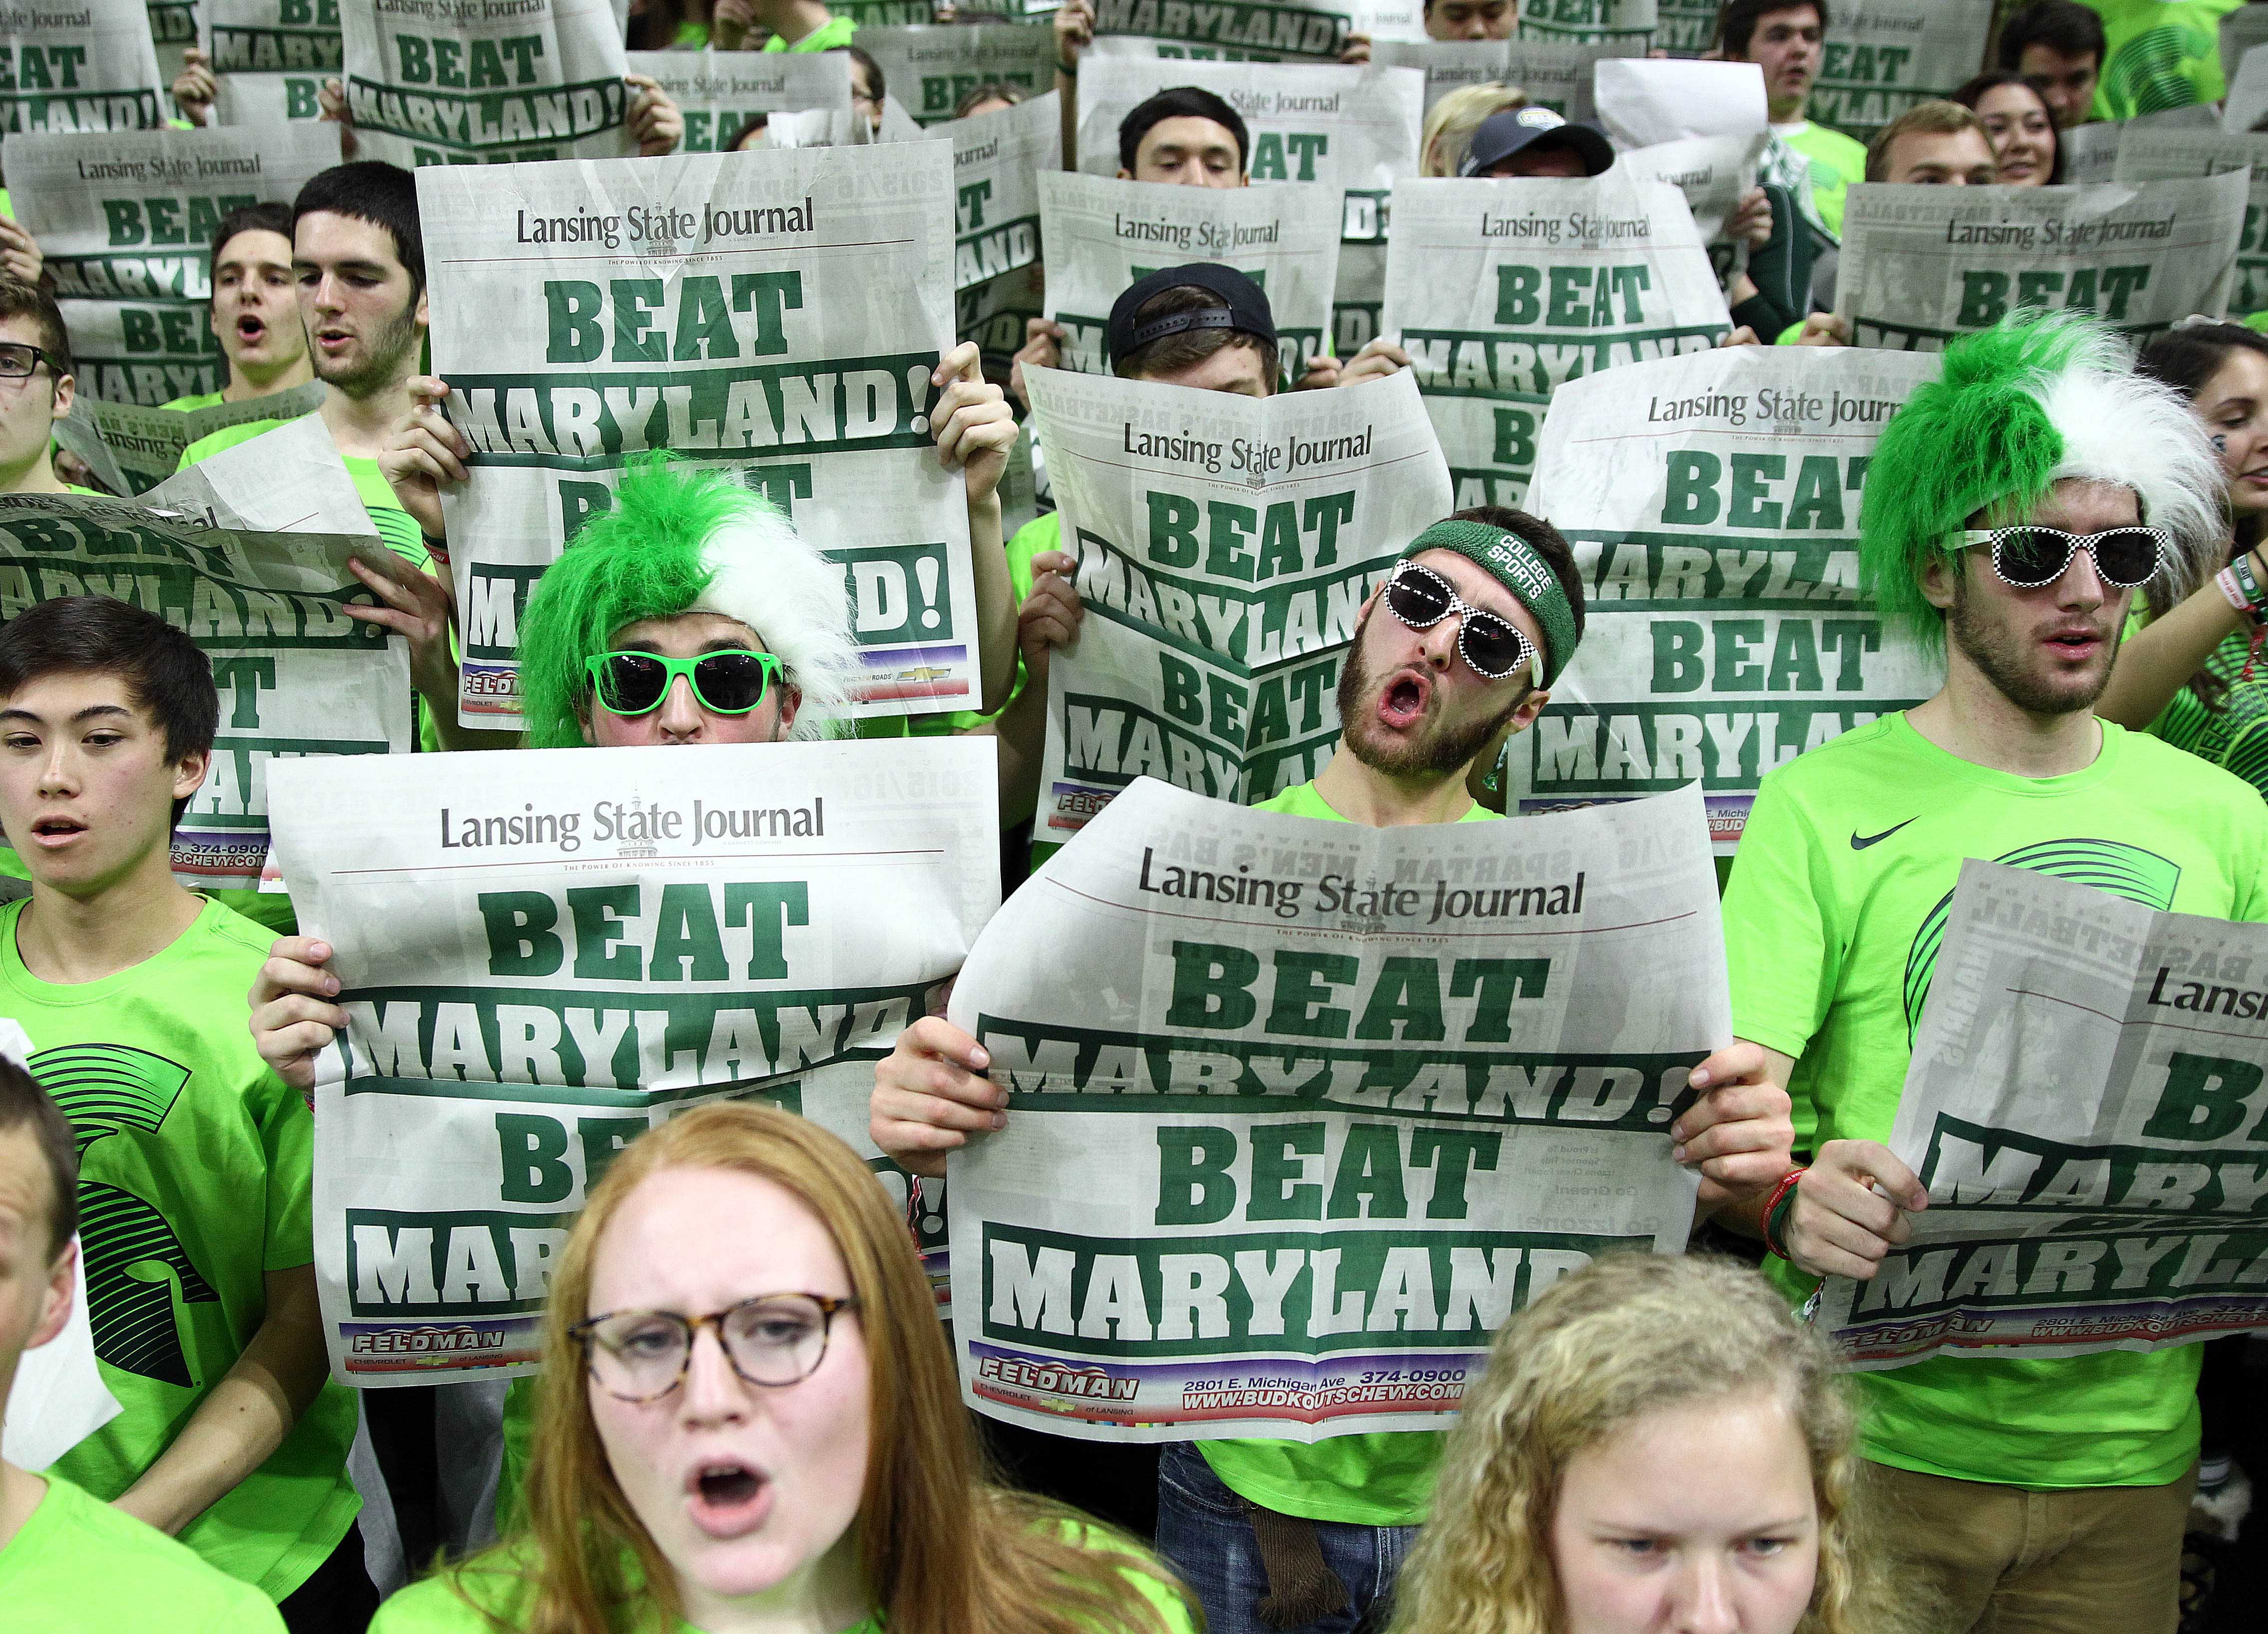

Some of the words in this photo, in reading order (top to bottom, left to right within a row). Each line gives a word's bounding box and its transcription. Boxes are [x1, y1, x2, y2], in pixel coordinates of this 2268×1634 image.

[396, 34, 544, 88] BEAT
[350, 81, 624, 147] MARYLAND!
[1230, 89, 1269, 112] State
[1275, 91, 1340, 114] Journal
[77, 158, 148, 182] Lansing
[196, 153, 261, 176] Journal
[517, 205, 620, 249] Lansing
[627, 204, 696, 243] State
[704, 197, 814, 244] Journal
[1115, 212, 1192, 250] Lansing
[1233, 218, 1279, 250] Journal
[1481, 211, 1561, 244] Lansing
[1947, 218, 2036, 250] Lansing
[2096, 212, 2176, 247] Journal
[544, 270, 804, 363] BEAT
[1494, 264, 1651, 328] BEAT
[1956, 264, 2152, 327] BEAT
[447, 365, 932, 457] MARYLAND!
[1648, 385, 1749, 426] Lansing
[1756, 387, 1823, 422] State
[1124, 422, 1223, 474] Lansing
[1231, 437, 1281, 475] State
[1286, 424, 1372, 474] Journal
[1147, 490, 1356, 583] BEAT
[1500, 534, 1554, 589] COLLEGE
[1486, 544, 1543, 600] SPORTS
[1650, 619, 1882, 693] BEAT
[1159, 650, 1338, 751] BEAT
[441, 802, 582, 852] Lansing
[593, 800, 682, 842] State
[692, 796, 824, 847] Journal
[1139, 846, 1303, 919] Lansing
[1316, 872, 1421, 918] State
[1427, 871, 1586, 926] Journal
[478, 880, 810, 982] BEAT
[1165, 940, 1552, 1043] BEAT
[983, 1030, 1693, 1125] MARYLAND!
[1154, 1121, 1502, 1226] BEAT
[352, 1330, 505, 1353] FELDMAN
[979, 1357, 1141, 1401] FELDMAN
[1182, 1382, 1466, 1411] WWW.BUDKOUTSCHEVY.COM
[1183, 1379, 1223, 1392] 2801
[1227, 1378, 1243, 1390] E.
[1247, 1377, 1317, 1394] Michigan
[1319, 1376, 1346, 1390] Ave
[1359, 1369, 1467, 1385] 374-0900
